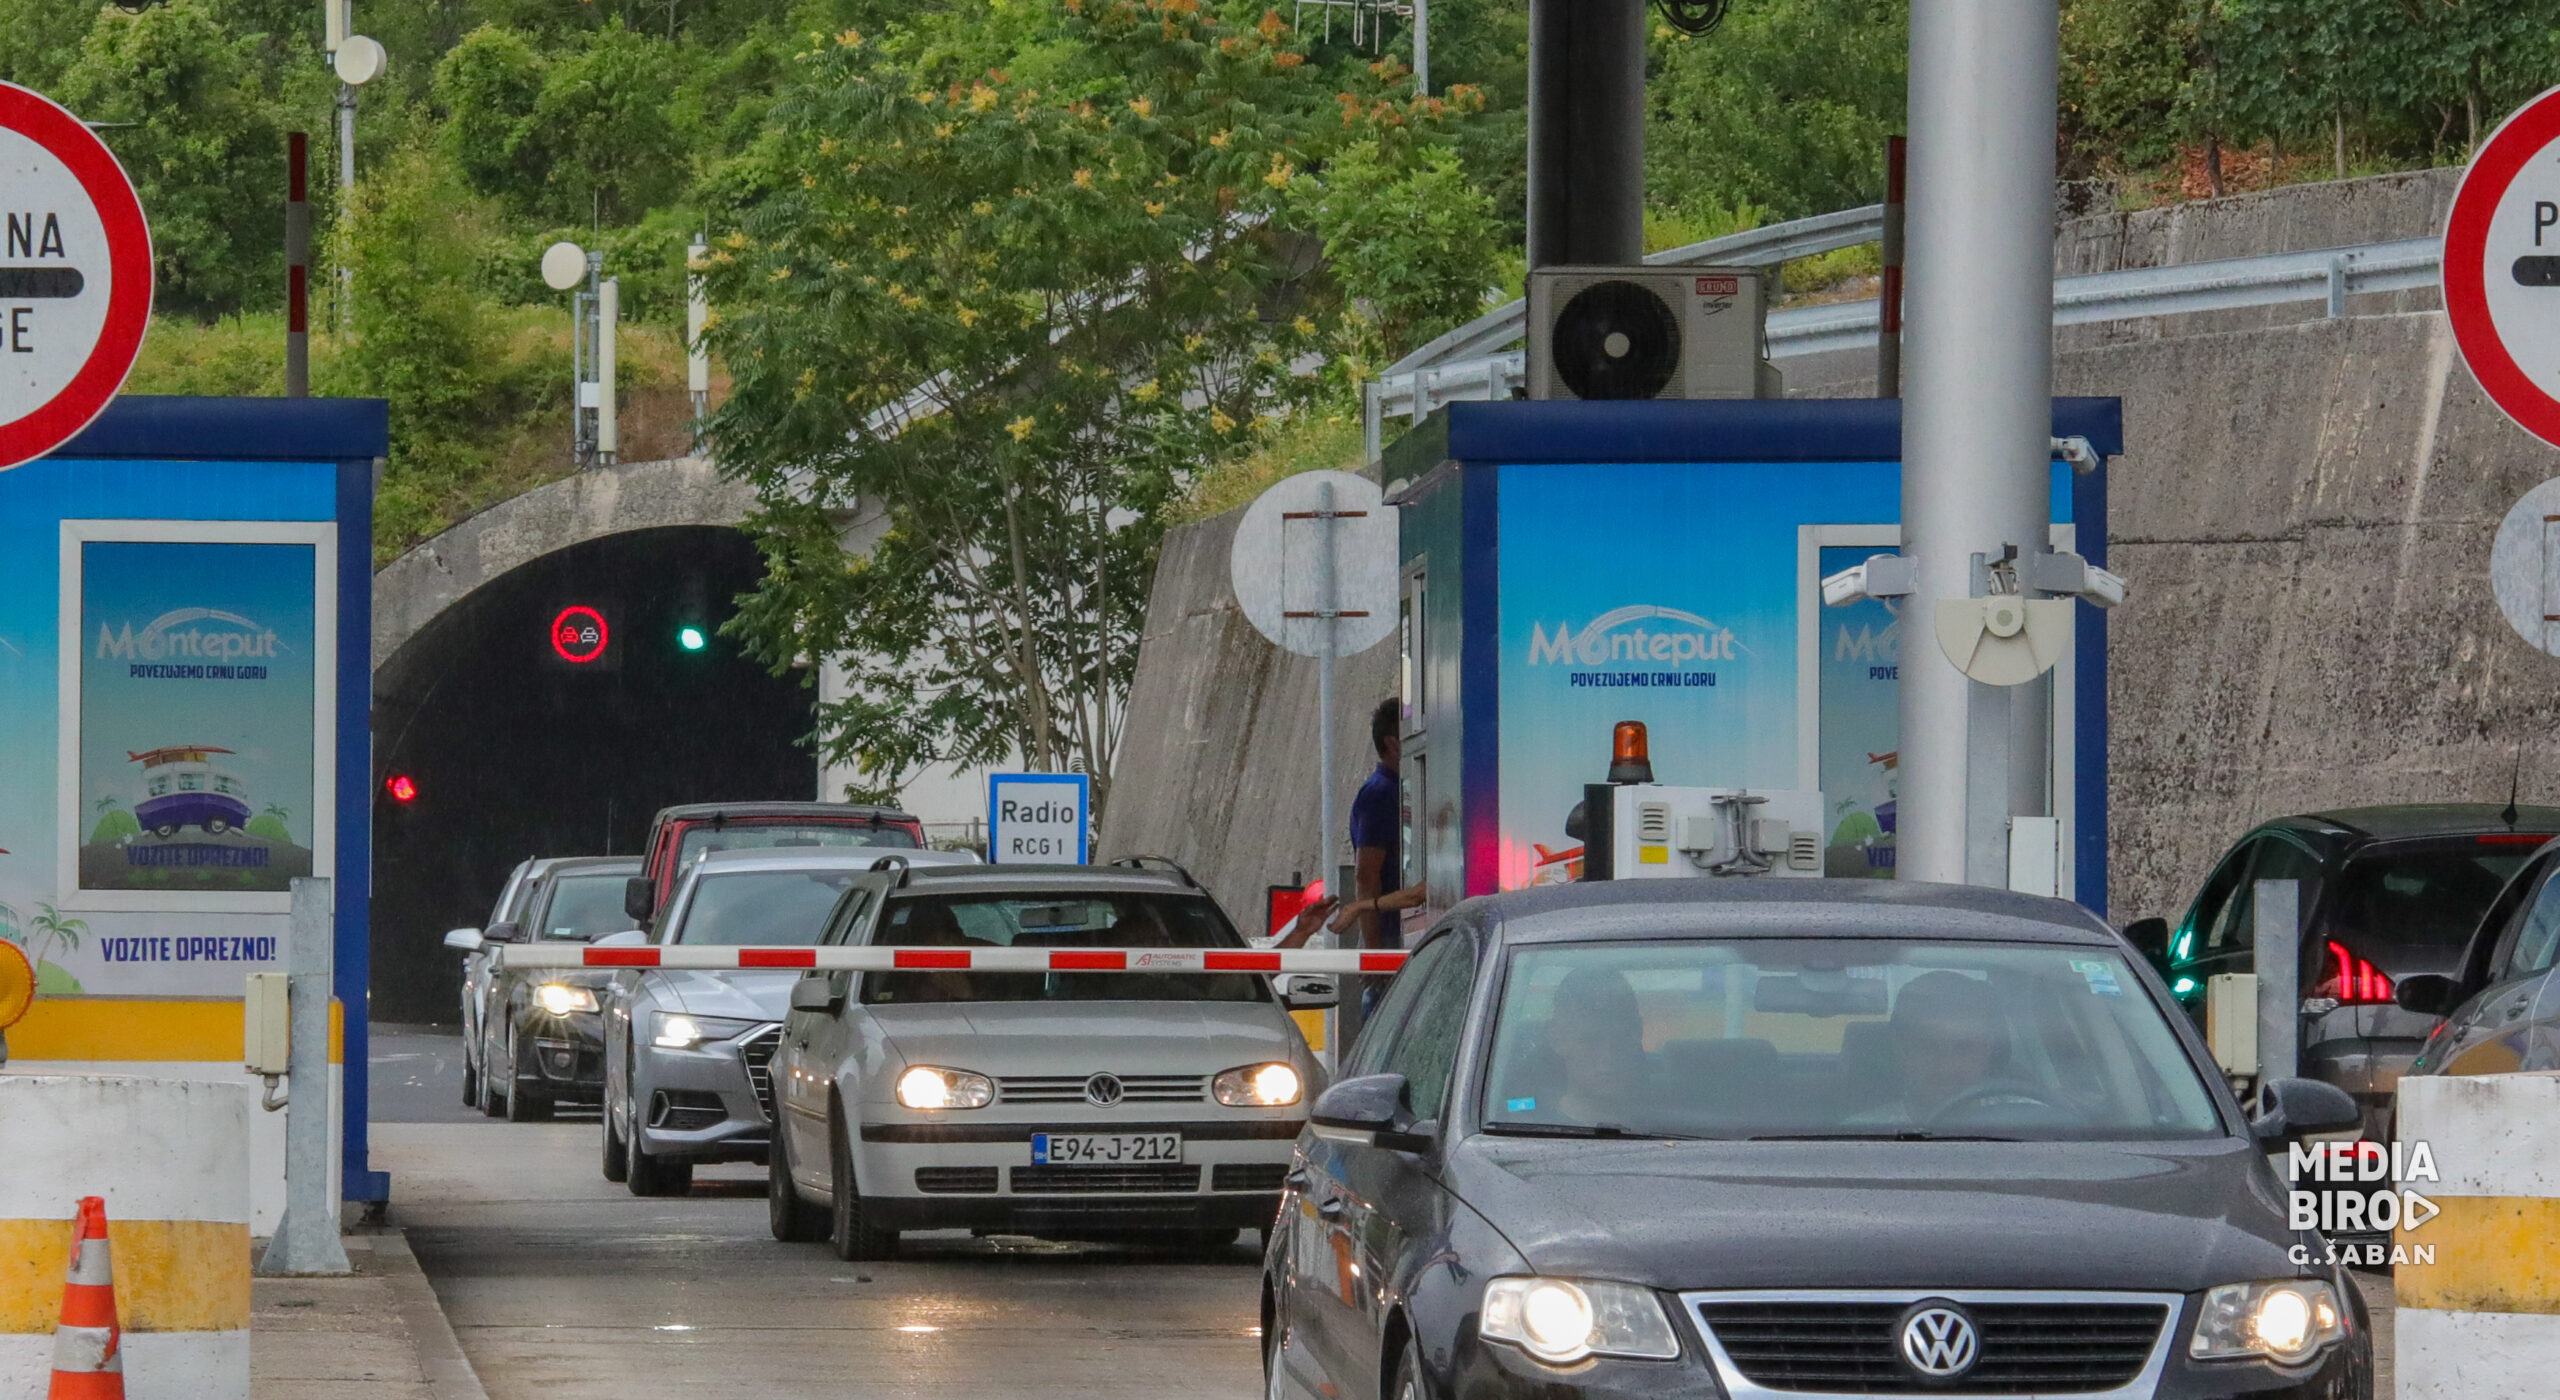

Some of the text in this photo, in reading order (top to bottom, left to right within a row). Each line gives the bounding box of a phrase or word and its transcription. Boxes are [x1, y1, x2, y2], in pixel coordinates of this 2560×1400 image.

[8, 212, 65, 258] NA
[2535, 201, 2559, 246] P
[0, 307, 33, 353] E
[96, 619, 277, 663] Monteput
[1528, 619, 1736, 668] Monteput
[130, 664, 267, 680] POVEZUJEMO CRNU GORU
[1570, 672, 1717, 687] POVEZUJEMO CRNU GORU
[1001, 800, 1074, 823] Radio
[127, 843, 270, 868] VOZITE OPREZNO!
[1013, 837, 1063, 855] RCG 1
[101, 937, 276, 961] VOZITE OPREZNO!
[1050, 1137, 1177, 1160] E94-J-212
[1904, 1308, 1976, 1375] VW
